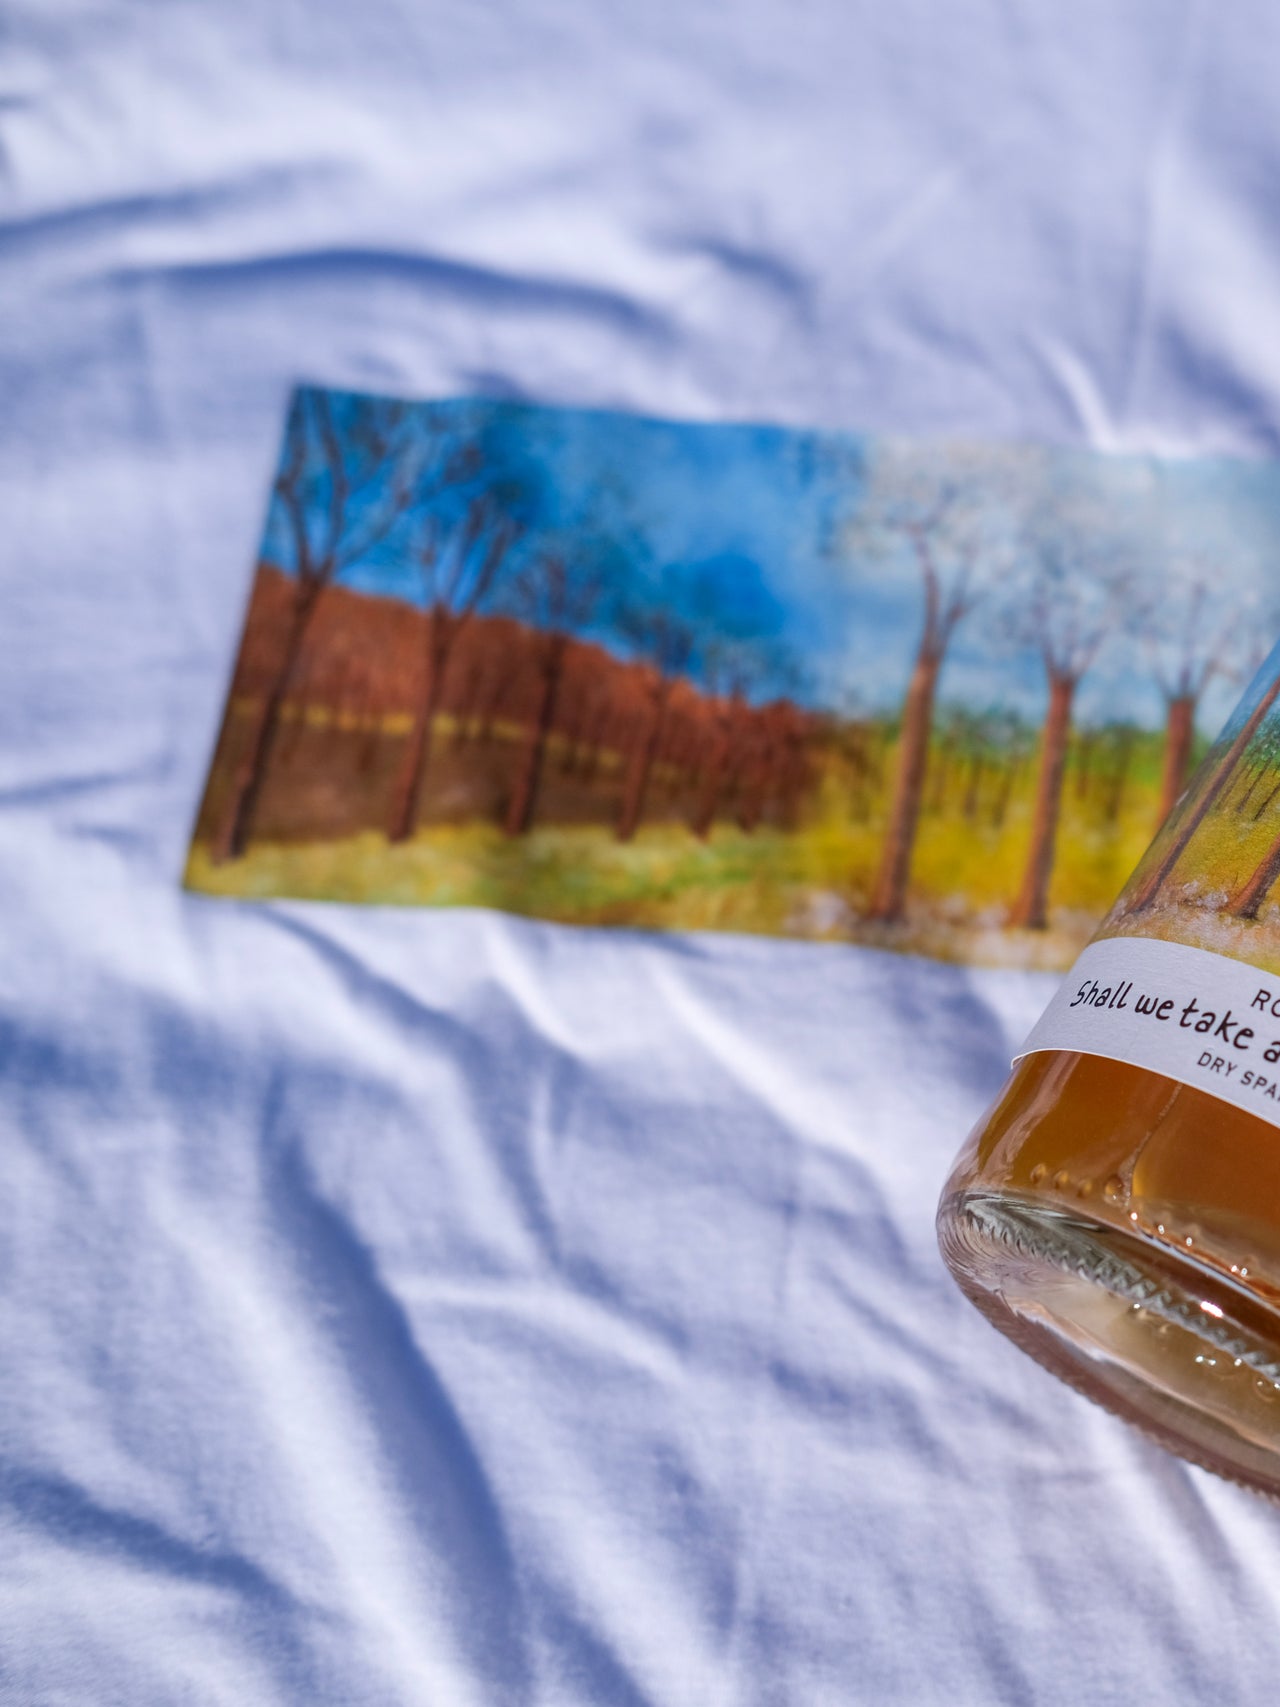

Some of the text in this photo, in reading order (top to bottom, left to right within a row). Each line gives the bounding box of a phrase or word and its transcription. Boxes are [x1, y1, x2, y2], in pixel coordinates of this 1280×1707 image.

[1069, 980, 1134, 1010] Shall
[1134, 994, 1175, 1020] we
[1179, 998, 1255, 1050] take
[1196, 1051, 1238, 1078] DRY
